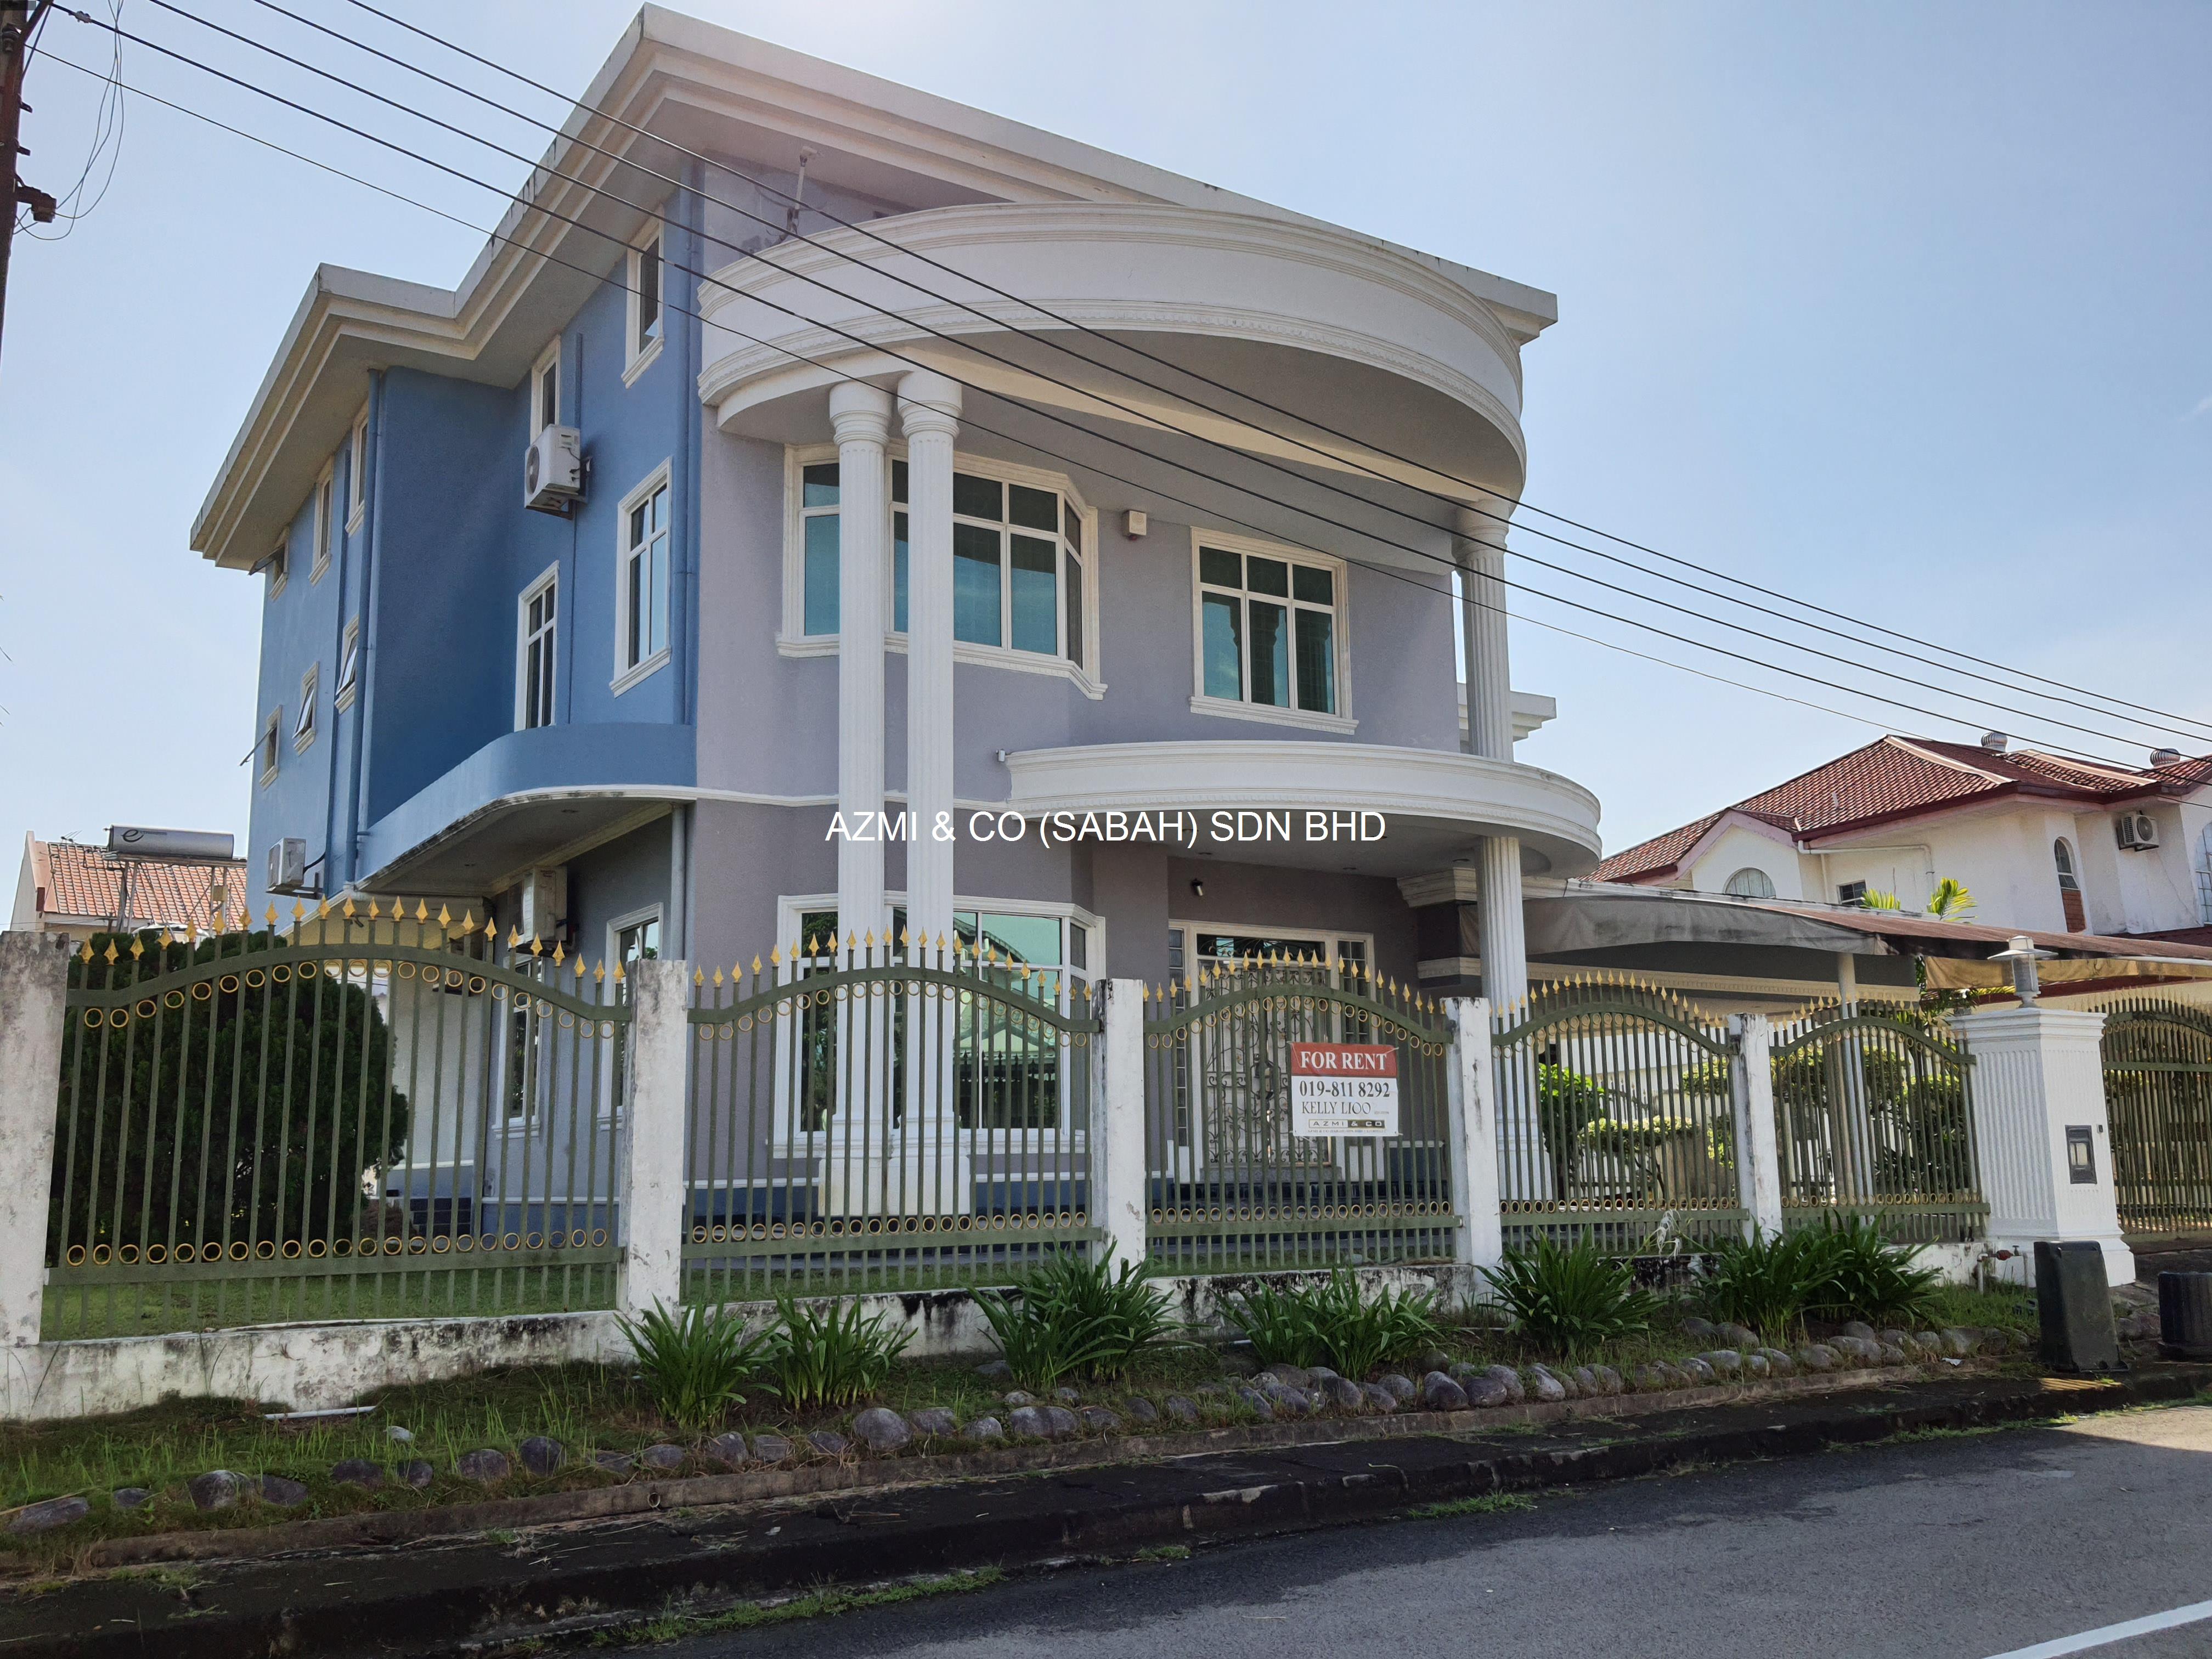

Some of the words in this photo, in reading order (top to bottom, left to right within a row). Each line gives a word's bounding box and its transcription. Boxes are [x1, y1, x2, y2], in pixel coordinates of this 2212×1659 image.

[1300, 1051, 1338, 1069] FOR
[1342, 1052, 1387, 1070] RENT
[1299, 1080, 1353, 1097] 019-811
[1358, 1081, 1390, 1098] 8292
[1302, 1101, 1338, 1114] KELLY
